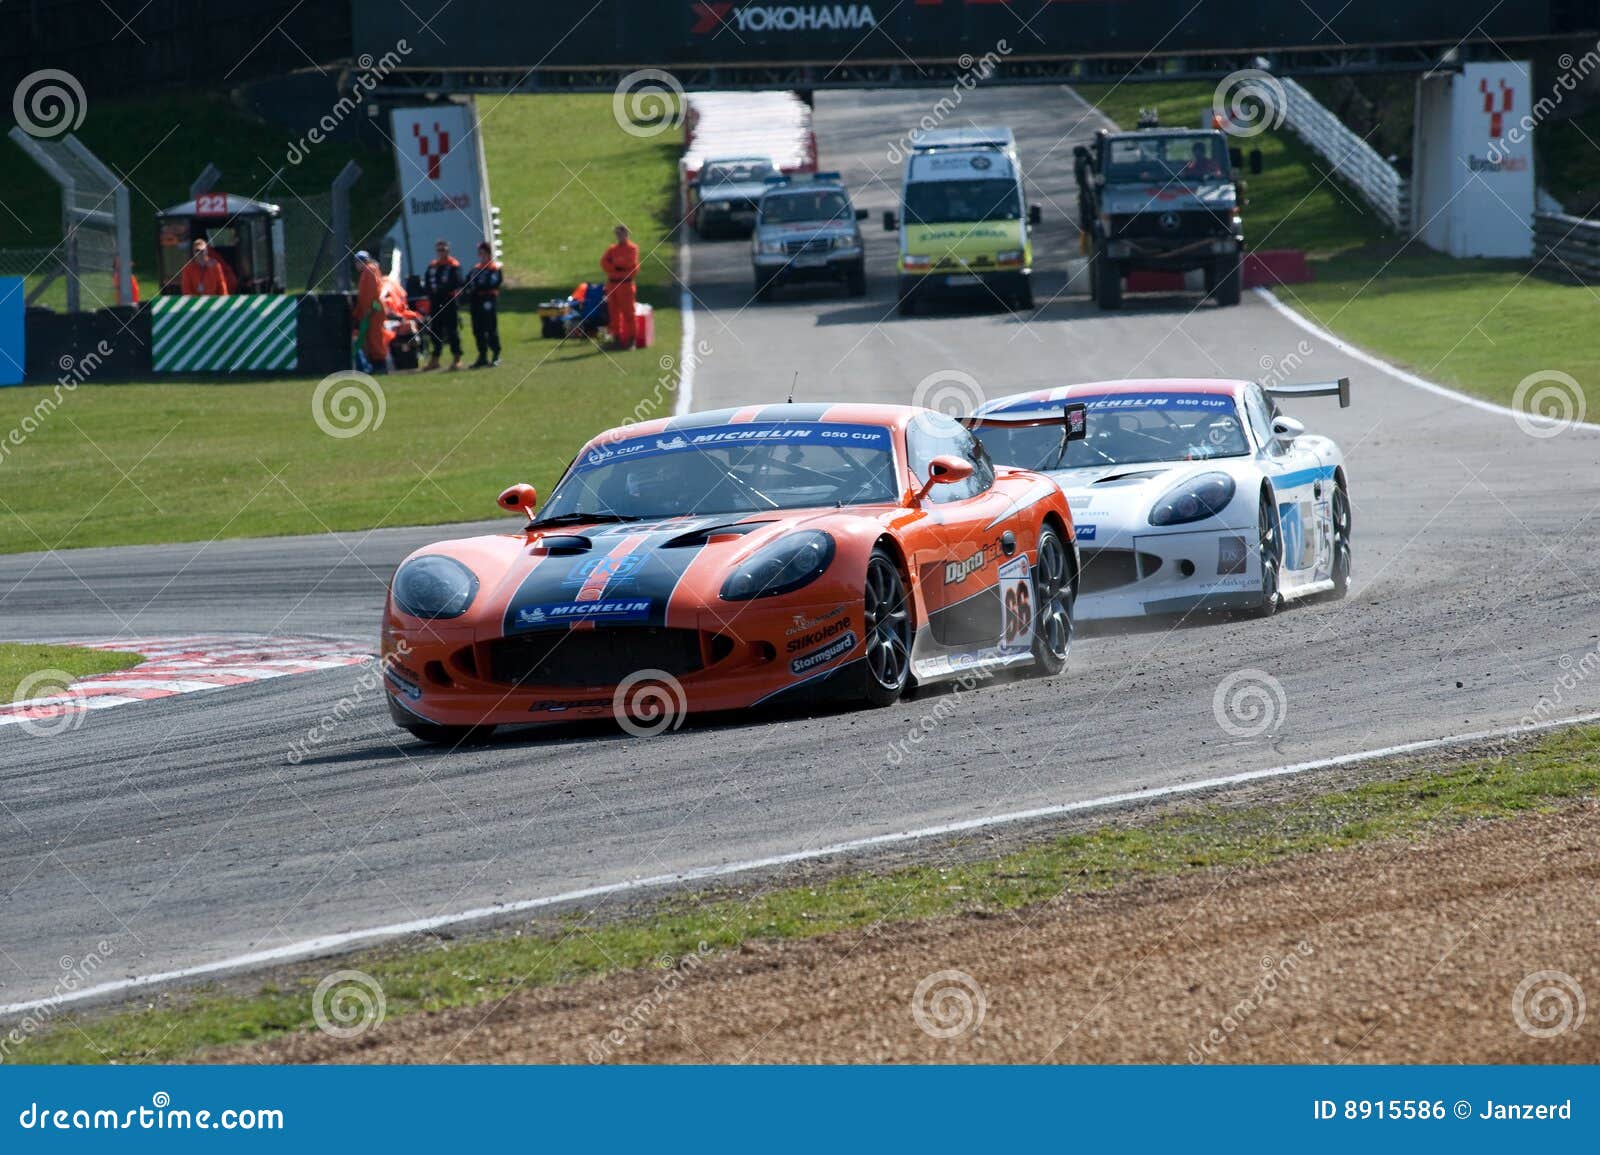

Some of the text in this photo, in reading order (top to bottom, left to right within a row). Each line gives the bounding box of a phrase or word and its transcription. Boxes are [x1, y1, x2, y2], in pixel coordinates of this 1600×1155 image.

[733, 5, 876, 31] YOKOHAMA
[198, 195, 224, 212] 22
[1084, 399, 1168, 408] ICHELIN
[617, 444, 645, 455] CUP
[693, 430, 812, 443] MICHELIN
[821, 431, 848, 439] G50
[852, 432, 881, 440] CUP
[550, 602, 649, 616] MICHELIN
[787, 617, 851, 653] Silkolene
[793, 635, 852, 671] Stormguard
